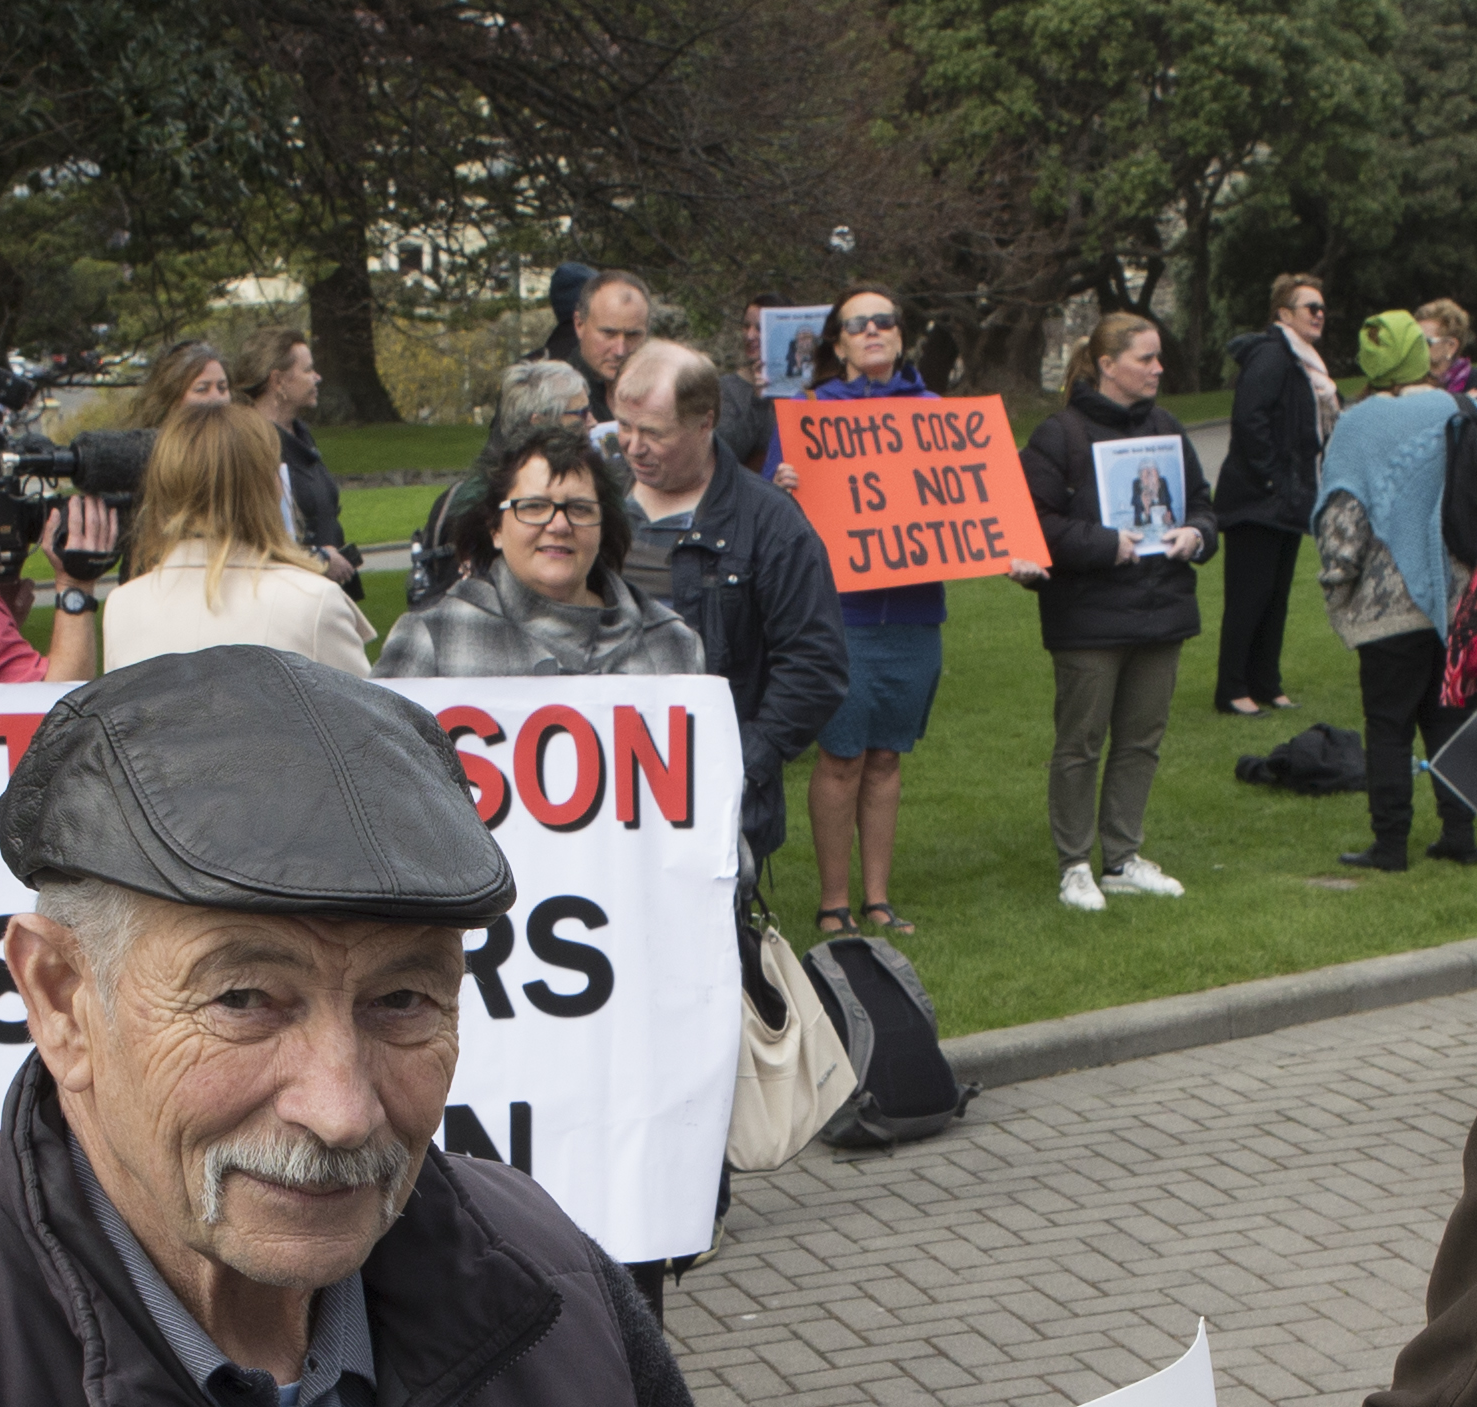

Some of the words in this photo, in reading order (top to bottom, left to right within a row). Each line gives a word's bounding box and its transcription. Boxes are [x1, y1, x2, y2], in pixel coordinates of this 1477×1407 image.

[911, 462, 990, 507] NOT
[846, 516, 1010, 574] JUSTICE
[435, 703, 695, 834] SON
